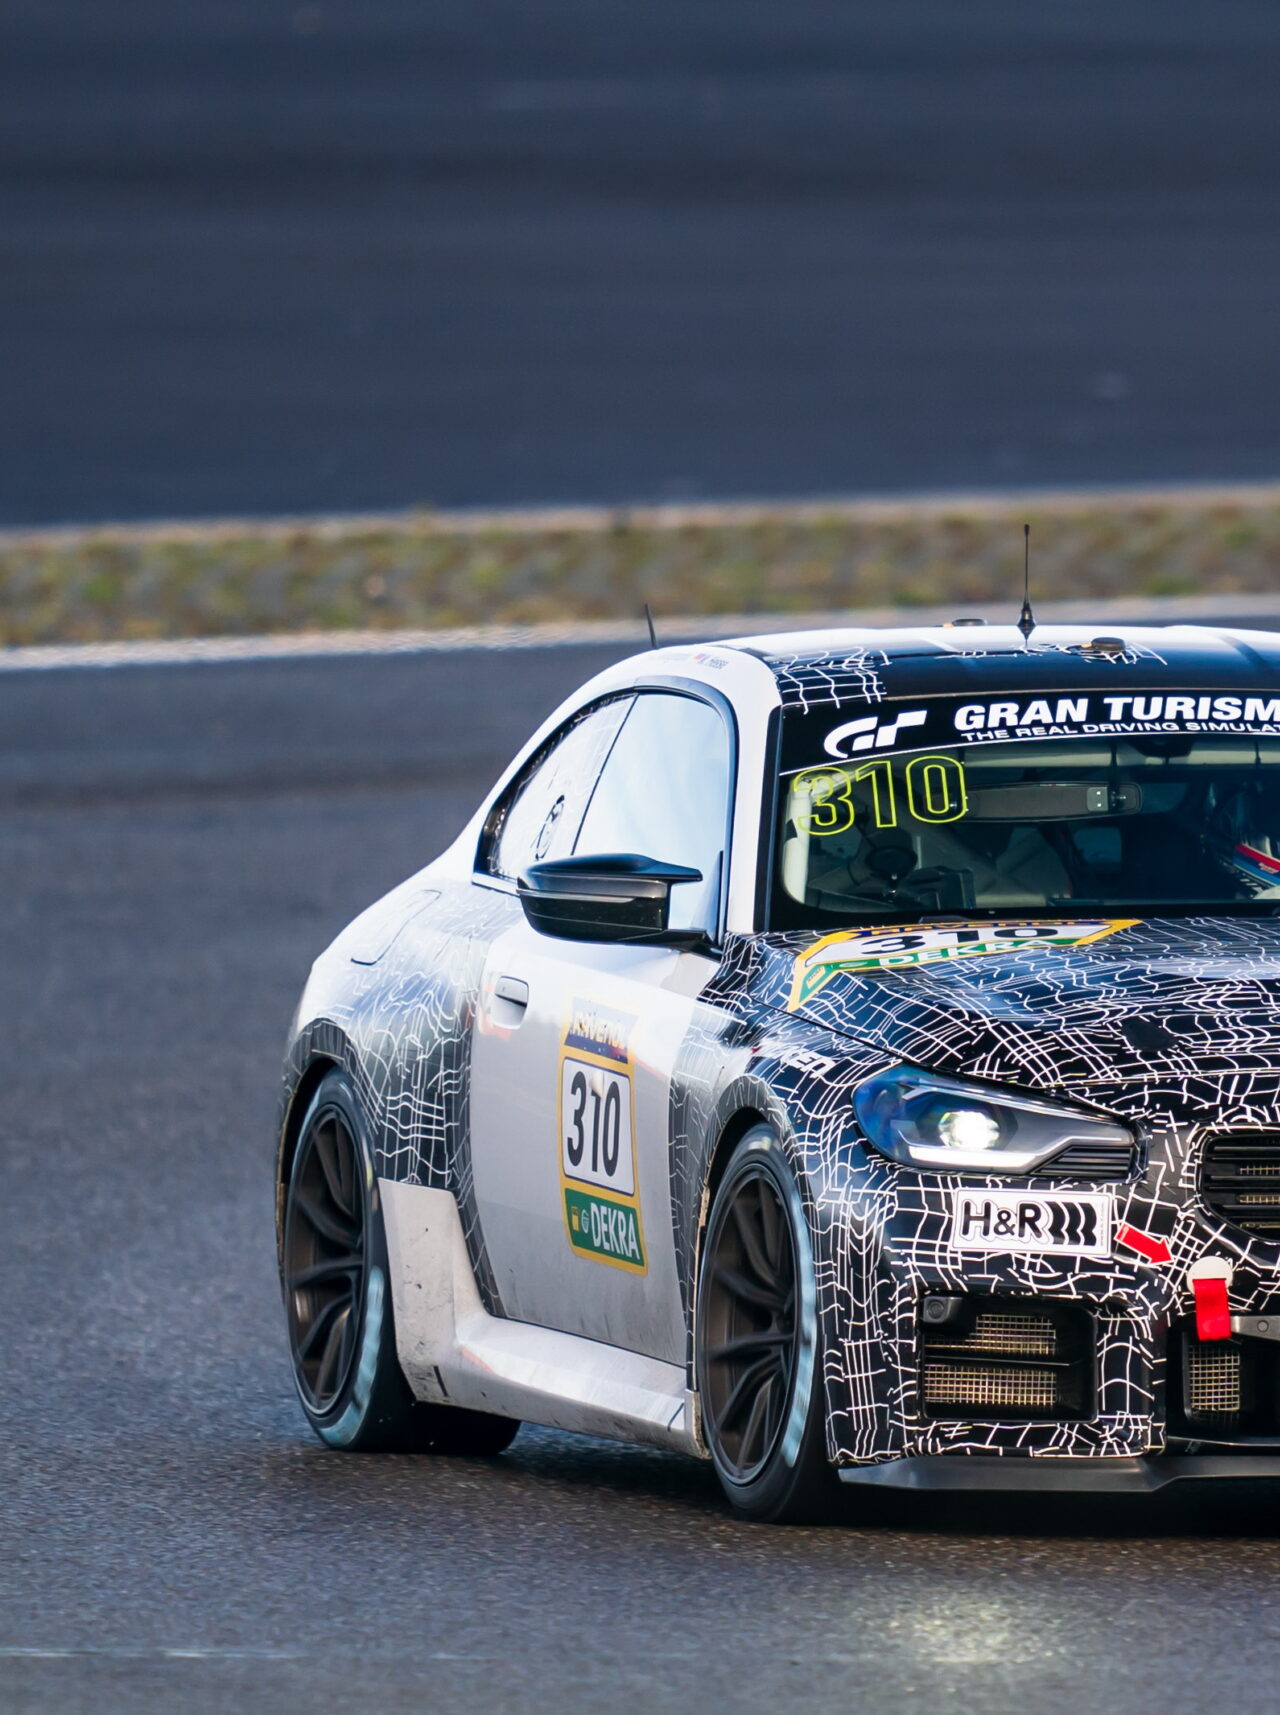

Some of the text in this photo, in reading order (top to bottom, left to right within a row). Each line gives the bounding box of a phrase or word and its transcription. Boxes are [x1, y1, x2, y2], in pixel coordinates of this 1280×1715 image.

[954, 698, 1089, 731] GRAN
[961, 729, 1010, 742] THE
[1015, 725, 1078, 737] REAL
[1082, 722, 1180, 733] DRIVING
[793, 755, 968, 836] 310
[861, 928, 1058, 955] 310
[879, 939, 1057, 966] DEKRA
[567, 1070, 621, 1178] 310
[590, 1202, 641, 1260] DEKRA
[962, 1201, 1043, 1239] H&R
